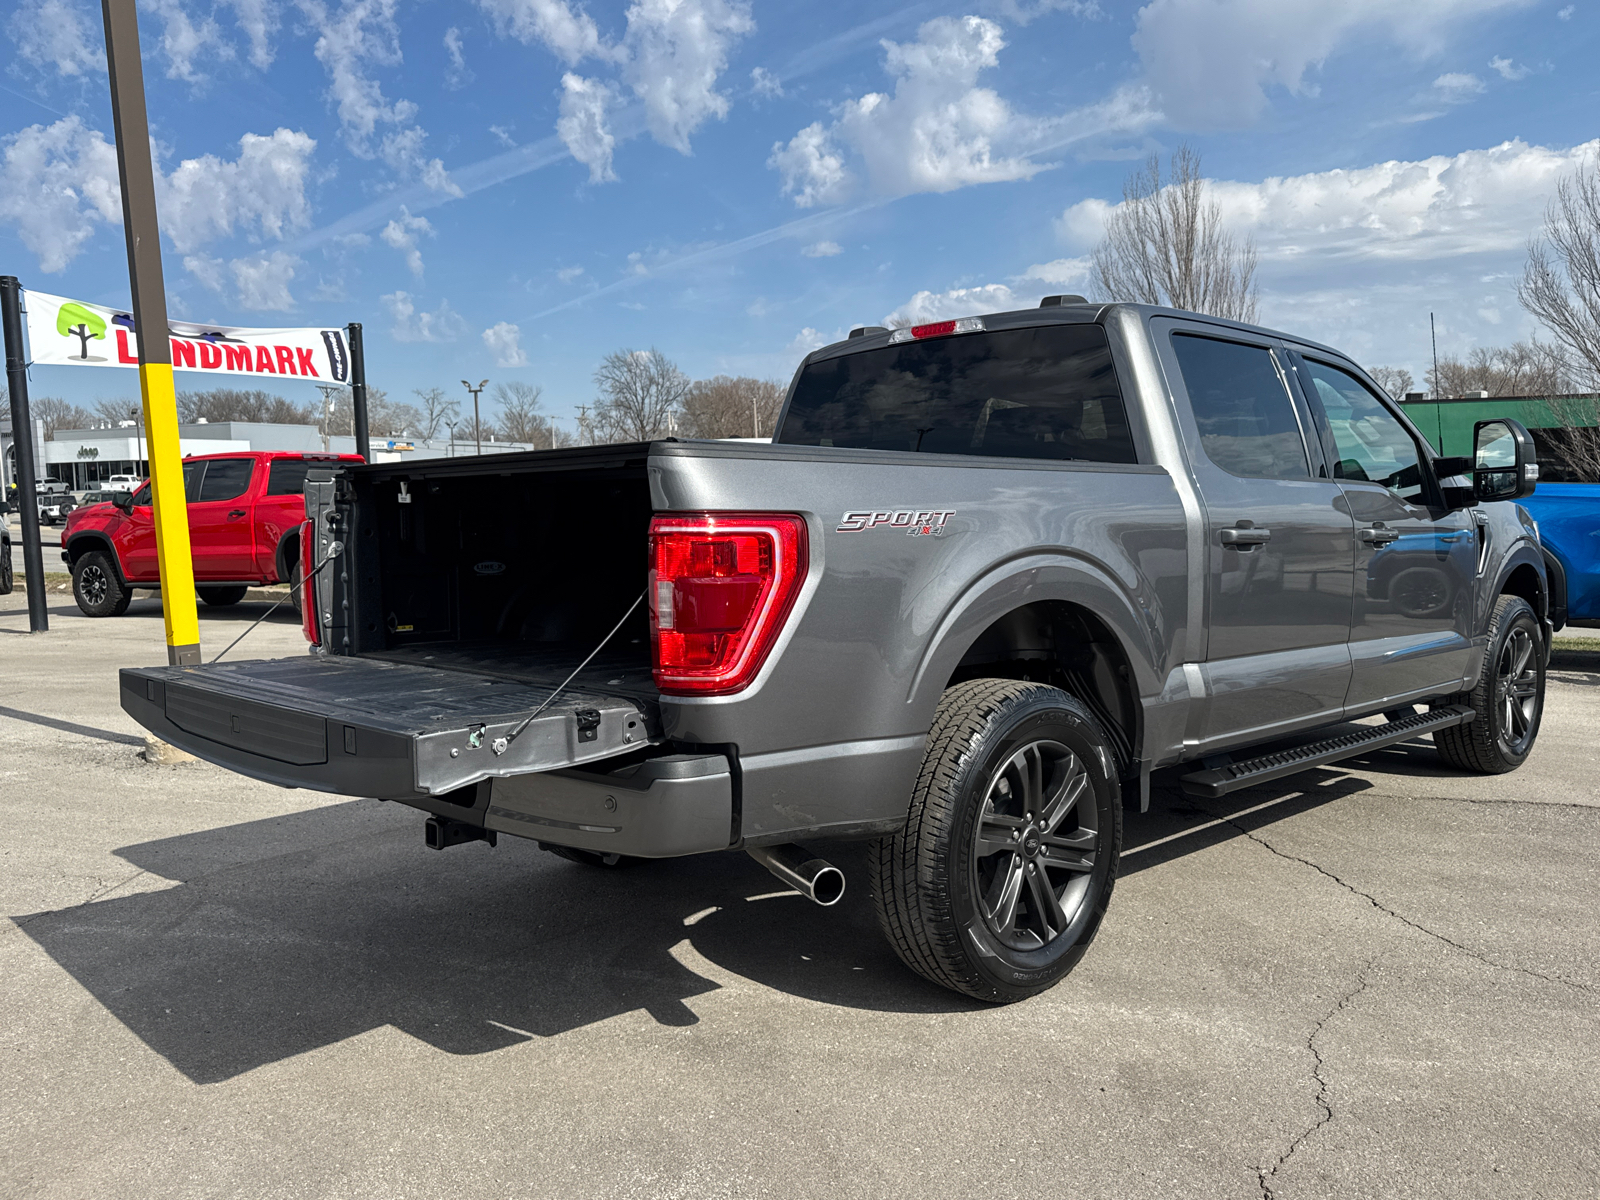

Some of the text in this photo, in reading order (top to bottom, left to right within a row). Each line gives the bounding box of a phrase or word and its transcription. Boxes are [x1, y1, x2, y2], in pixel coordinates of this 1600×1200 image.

[116, 329, 320, 378] LNDMARK
[328, 331, 343, 379] PRE-OWNED
[836, 509, 956, 533] SPORT
